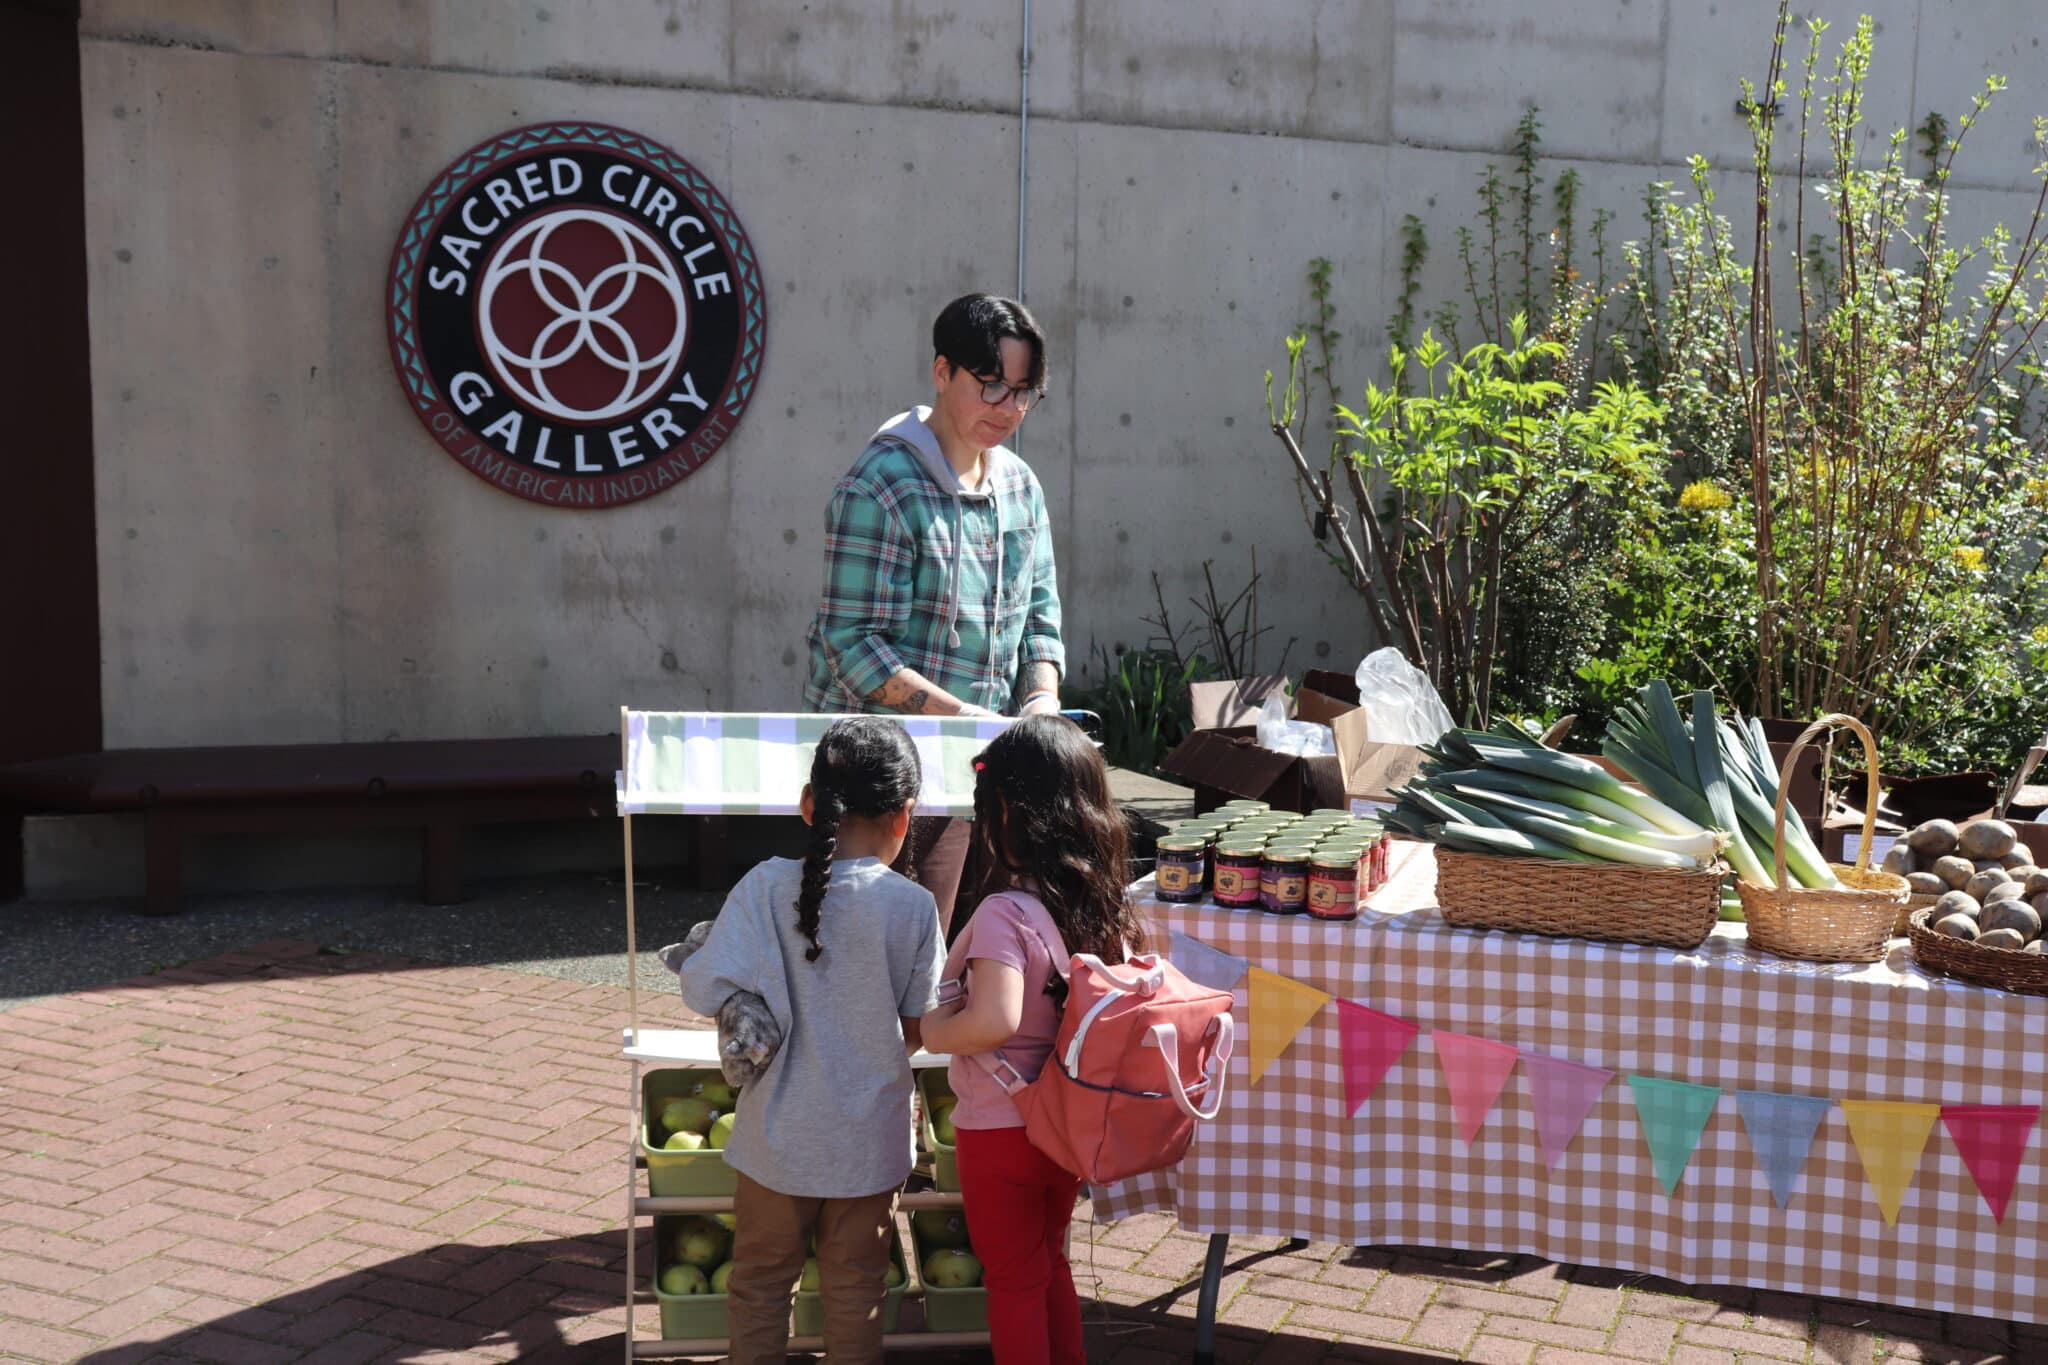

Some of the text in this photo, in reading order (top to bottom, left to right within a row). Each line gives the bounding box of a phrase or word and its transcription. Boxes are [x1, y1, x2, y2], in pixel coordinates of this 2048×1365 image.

[428, 157, 732, 300] SACRED CIRCLE
[432, 412, 729, 504] OF AMERICAN INDIAN ART
[450, 371, 709, 473] GALLERY
